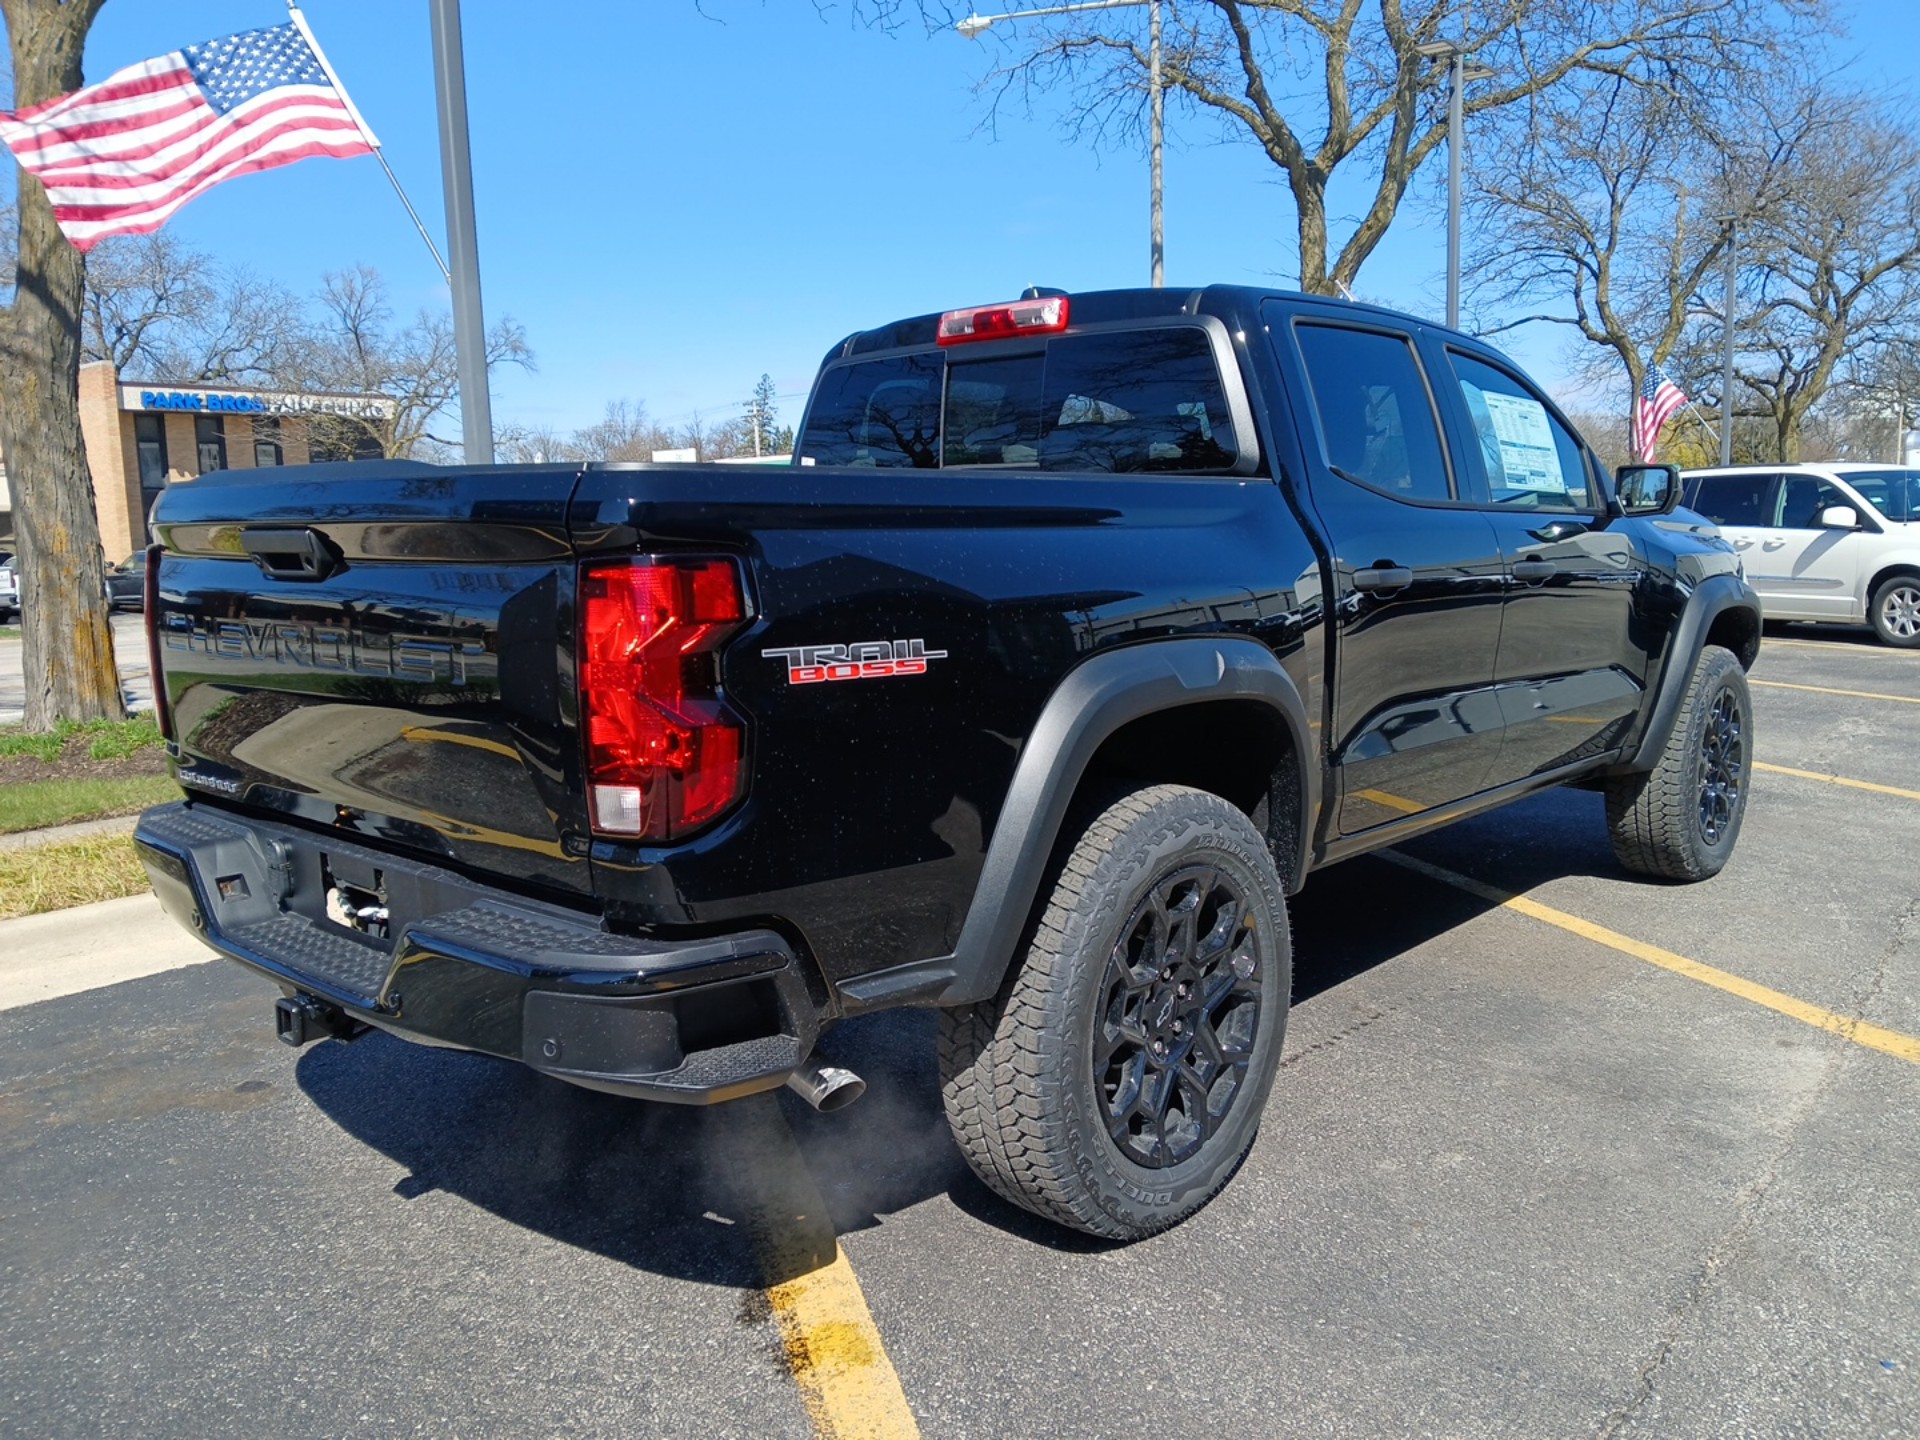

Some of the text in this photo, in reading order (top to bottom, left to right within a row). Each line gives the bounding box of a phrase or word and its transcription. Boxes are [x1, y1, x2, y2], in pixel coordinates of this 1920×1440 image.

[141, 391, 202, 409] PARK
[164, 611, 485, 685] CHEVROLET
[762, 639, 948, 667] TRAIL
[789, 657, 927, 684] BOSS
